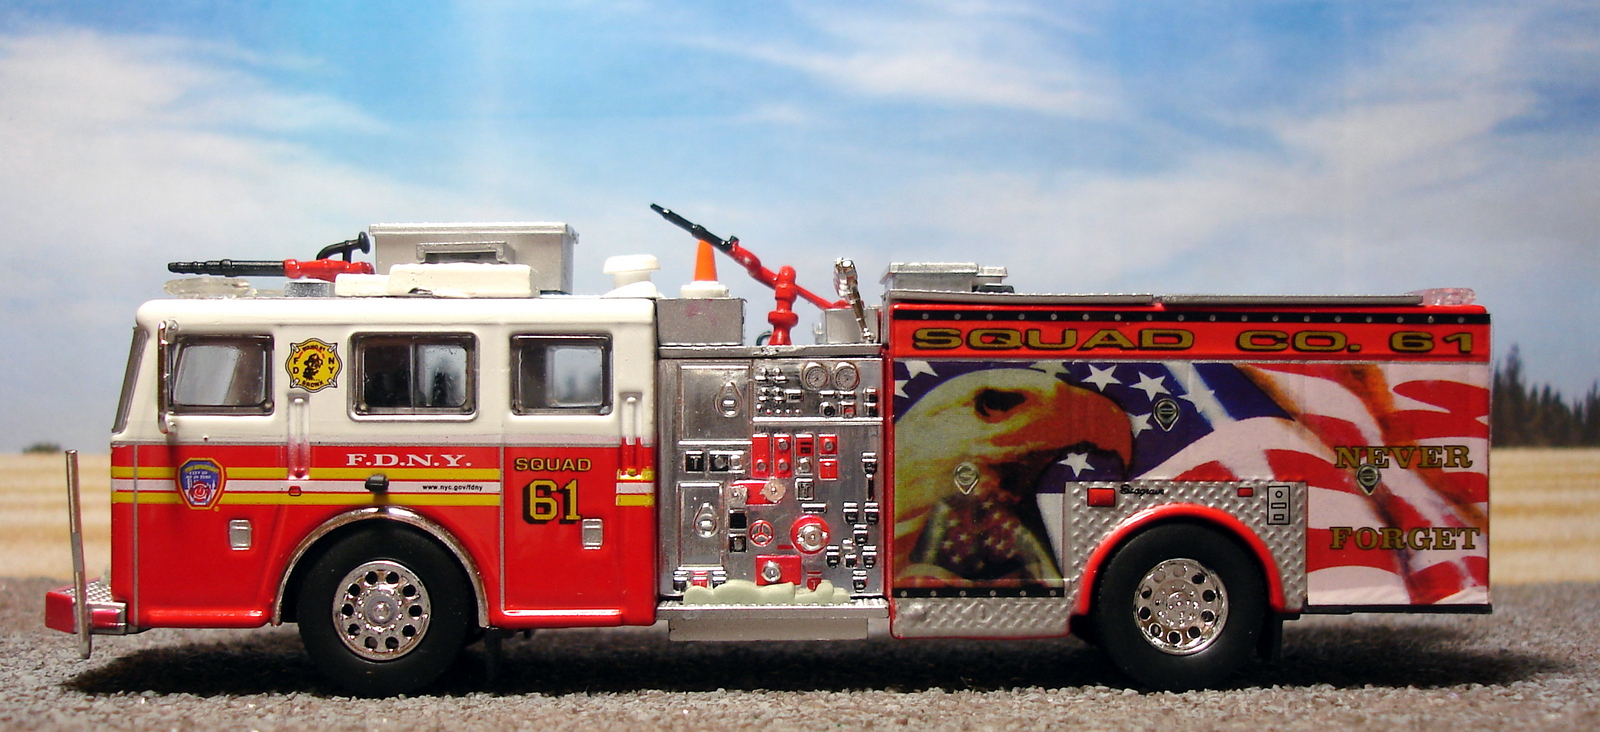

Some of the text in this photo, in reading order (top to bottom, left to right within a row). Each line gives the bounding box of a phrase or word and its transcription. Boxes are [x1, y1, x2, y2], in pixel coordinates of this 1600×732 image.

[912, 328, 1474, 353] SQUAD CO. 61
[346, 453, 472, 467] F.D.N.Y.
[515, 457, 592, 471] SQUAD
[1334, 446, 1473, 468] NEVER
[422, 483, 483, 492] www.nyc.gov/fdny
[522, 479, 582, 525] 61
[1329, 526, 1481, 550] FORGET
